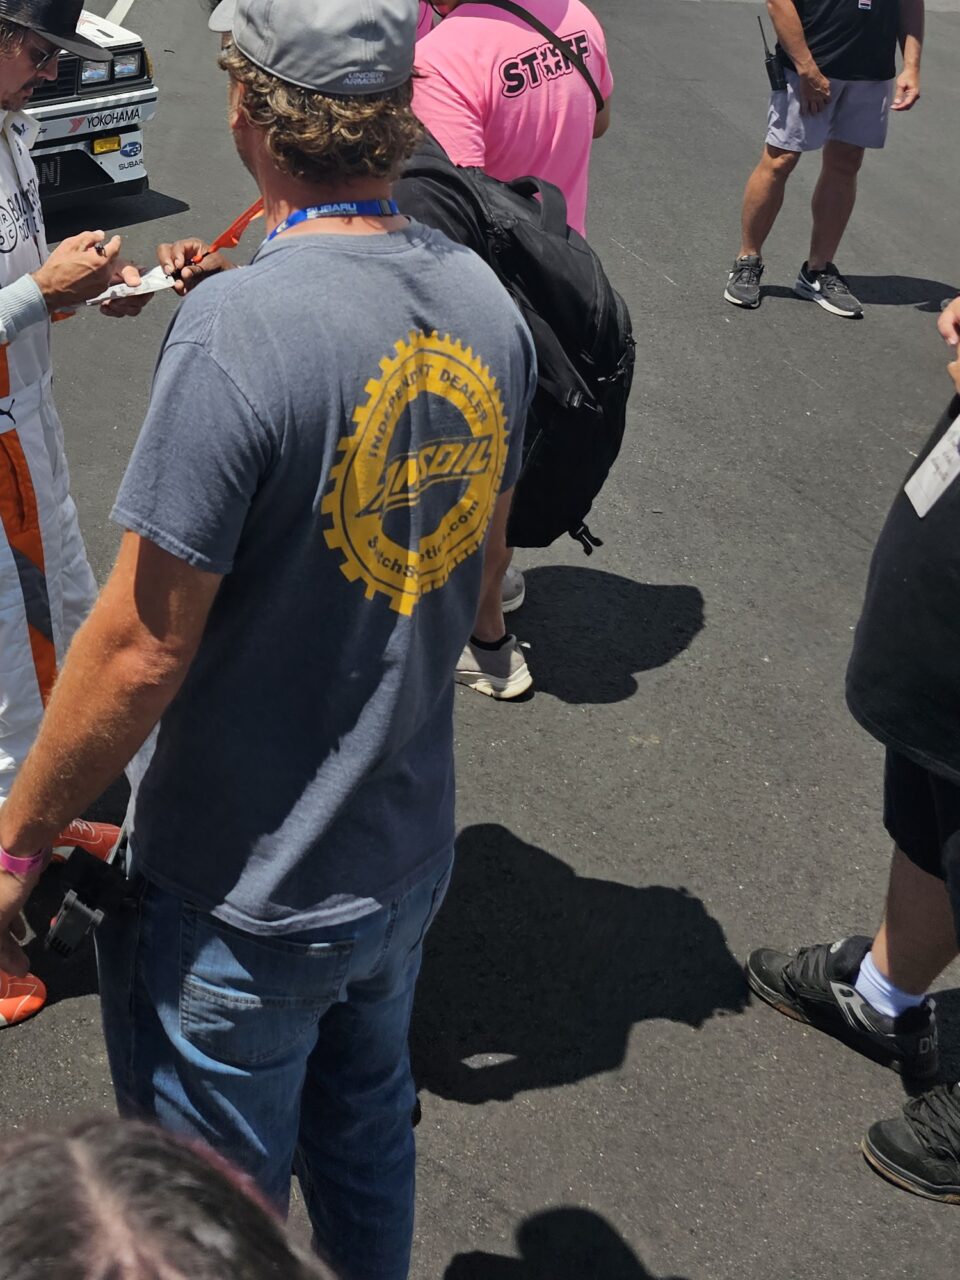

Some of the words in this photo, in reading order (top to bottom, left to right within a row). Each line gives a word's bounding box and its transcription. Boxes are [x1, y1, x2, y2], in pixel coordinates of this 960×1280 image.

[343, 77, 387, 85] ARMOUR
[87, 108, 141, 129] YOKOHAMA
[306, 203, 357, 215] SUBARU
[440, 368, 488, 421] DEALER
